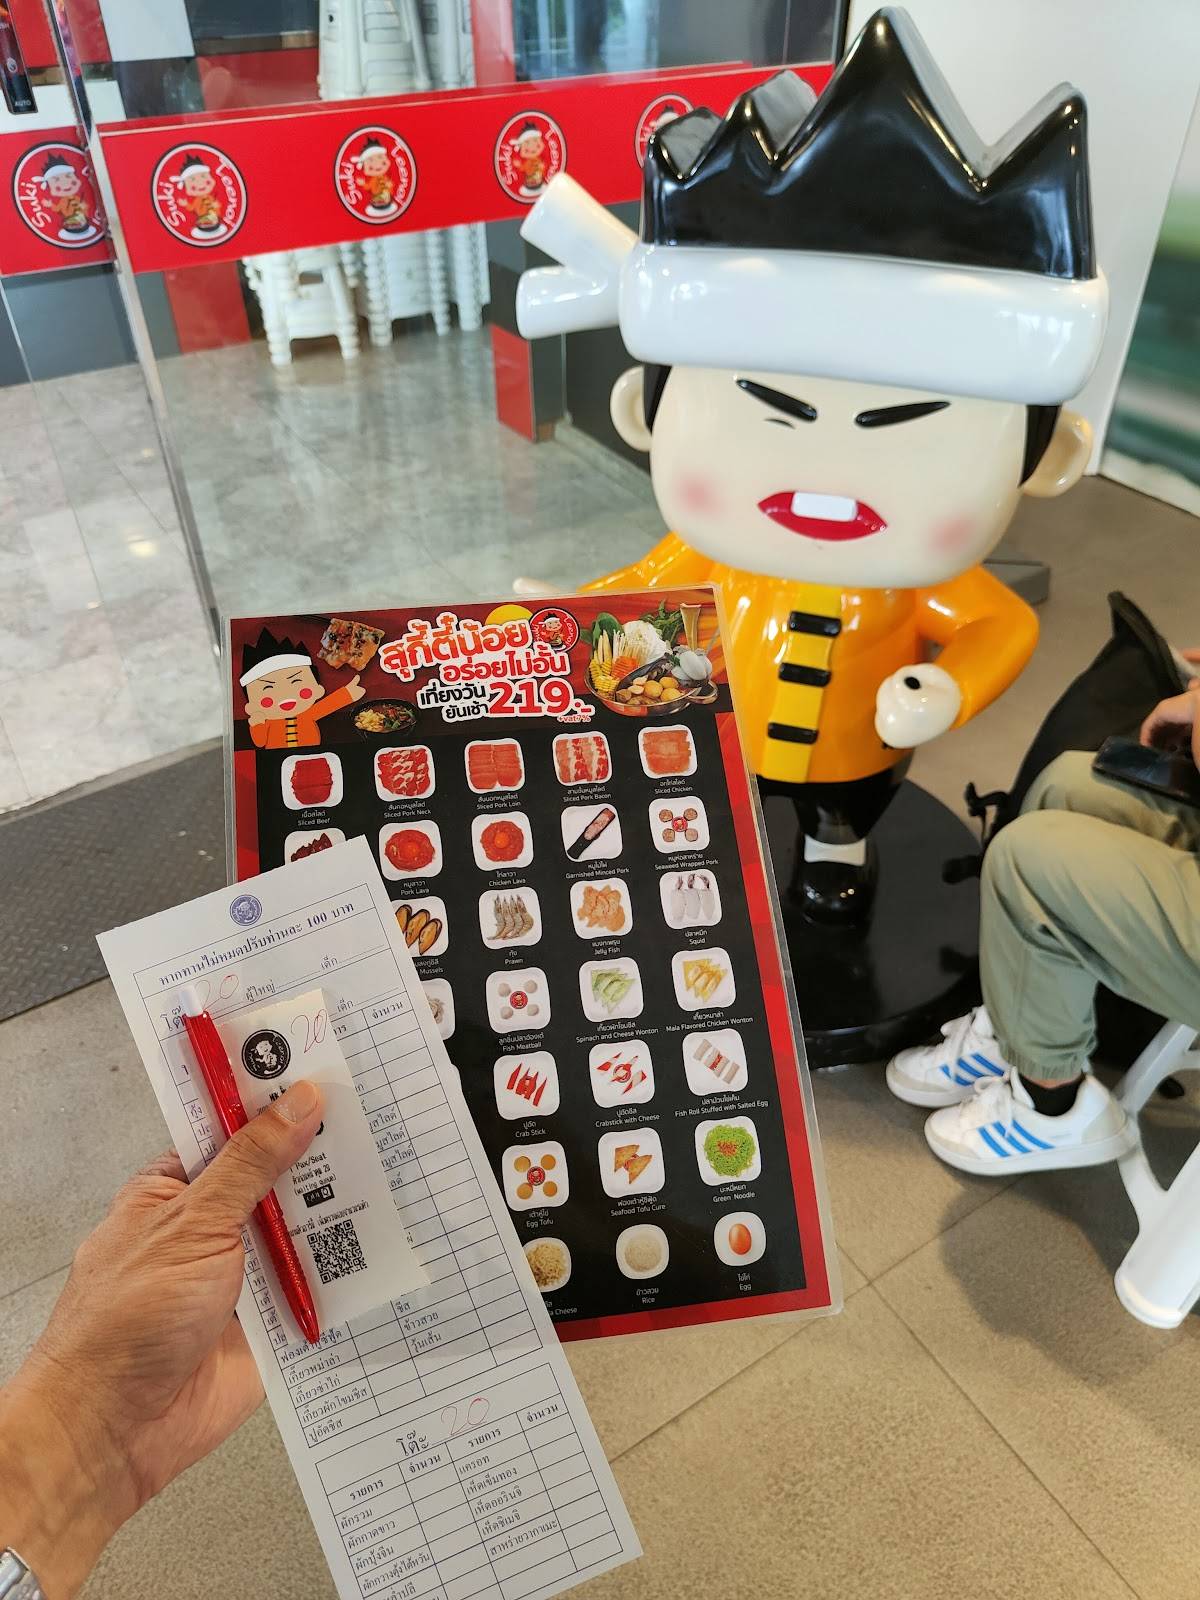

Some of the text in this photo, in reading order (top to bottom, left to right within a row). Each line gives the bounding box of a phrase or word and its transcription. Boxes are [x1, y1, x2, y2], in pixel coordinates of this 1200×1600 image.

[499, 143, 519, 186] Suki
[157, 181, 187, 227] Suki
[215, 155, 239, 228] Teenoi
[339, 161, 363, 206] Suki
[19, 181, 52, 228] Suki
[382, 614, 528, 679] สุกี้ตี๋น้อย
[443, 645, 567, 682] อร่อยไม่อั้น
[420, 679, 486, 706] เที่ยงวัน
[446, 700, 489, 719] ยันเช้า
[563, 793, 611, 803] Sliced Pork Bacon
[654, 785, 693, 795] Sliced Chicken
[416, 808, 431, 816] Neck
[476, 800, 521, 810] Sliced Pork Loin
[297, 817, 331, 827] Sliced Beef
[565, 866, 630, 879] Garnished Minced Pork
[654, 858, 719, 871] Seaweed Wrapped Pork
[488, 877, 526, 887] Chicken Lava
[400, 886, 430, 896] Pork Lava
[160, 902, 354, 986] หากทานไม่หมดปรับท่านละ 100 บาท
[689, 937, 706, 946] Squid
[594, 946, 621, 956] Jelly Fish
[504, 957, 524, 965] Prawn
[245, 955, 338, 1001] ผู้ใหญ่ เด็ก
[419, 966, 444, 975] Mussels
[336, 997, 354, 1013] เด็ก
[372, 1001, 403, 1020] จำนวน
[160, 1005, 185, 1031] โต๊
[666, 1016, 754, 1032] Mala Flavored Chicken Wonton
[576, 1027, 659, 1044] Spinach and Cheese Wonton
[503, 1041, 542, 1052] Fish Meatball
[675, 1099, 769, 1118] Fish Roll Stuffed with Salted Egg
[595, 1113, 660, 1128] Crabstick with Cheese
[515, 1127, 546, 1138] Crab Stick
[713, 1191, 756, 1203] Green Noodle
[610, 1203, 666, 1217] Seafood Tofu Cure
[526, 1218, 554, 1229] Egg Tofu
[739, 1283, 752, 1292] Egg
[396, 1299, 410, 1313] ชีส
[641, 1296, 656, 1304] Rice
[555, 1306, 578, 1316] Cheese
[403, 1311, 439, 1331] ข้าวสวย
[410, 1332, 442, 1353] วุ้นเส้น
[440, 1397, 490, 1436] 20
[308, 1418, 344, 1443] ปูอัดชีส
[349, 1403, 559, 1500] รายการ จำนวน รายการ จำนวน
[395, 1430, 430, 1457] โต๊ะ
[339, 1454, 491, 1530] ผักรวม แครอท
[347, 1466, 518, 1551] ผักกาดขาว เห็ดเข็มทอง
[354, 1485, 523, 1572] ผักบุ้งจีน เห็ดออรินจิ
[489, 1519, 560, 1557] สาหร่ายวากาเมะ
[362, 1552, 431, 1593] ผักกวางตุ้งไต้หวัน
[481, 1509, 522, 1537] เห็ดชิเมจิ
